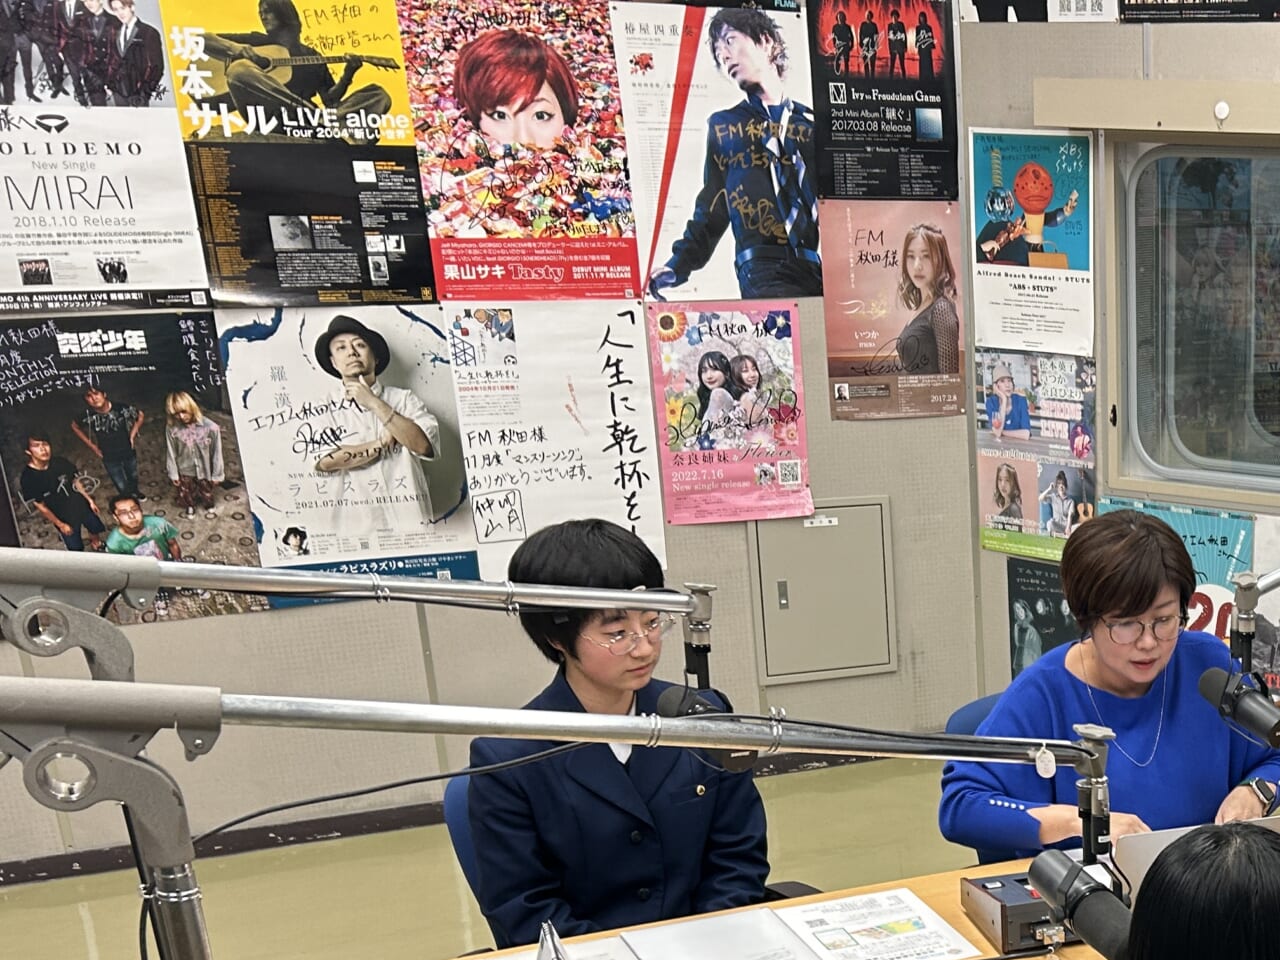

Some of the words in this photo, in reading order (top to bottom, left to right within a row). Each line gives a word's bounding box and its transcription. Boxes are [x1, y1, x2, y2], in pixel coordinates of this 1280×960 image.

[915, 90, 942, 103] Game
[184, 101, 278, 139] サトル
[282, 106, 339, 128] LIVE
[346, 108, 410, 129] alone
[831, 108, 844, 118] 2nd
[845, 109, 860, 118] Mini
[881, 121, 912, 132] Release
[32, 160, 58, 170] New
[62, 159, 96, 172] Single
[4, 175, 134, 211] MIRAI
[14, 216, 78, 228] 2018.1.10
[83, 215, 136, 227] Release
[855, 228, 884, 246] FM
[444, 264, 506, 280] 果山サキ
[508, 263, 565, 282] Tasty
[32, 294, 88, 303] ANNIVERSARY
[57, 328, 148, 354] 突然少年
[854, 330, 880, 340] いつか
[1, 367, 58, 393] SELECTION
[466, 430, 493, 449] FM
[498, 426, 549, 446] 秋田様
[673, 452, 730, 466] 奈良姉妹
[469, 464, 593, 491] ありがとうございます。
[672, 470, 724, 482] 2022.7.16
[672, 482, 693, 493] New
[694, 482, 718, 493] single
[720, 481, 750, 490] release
